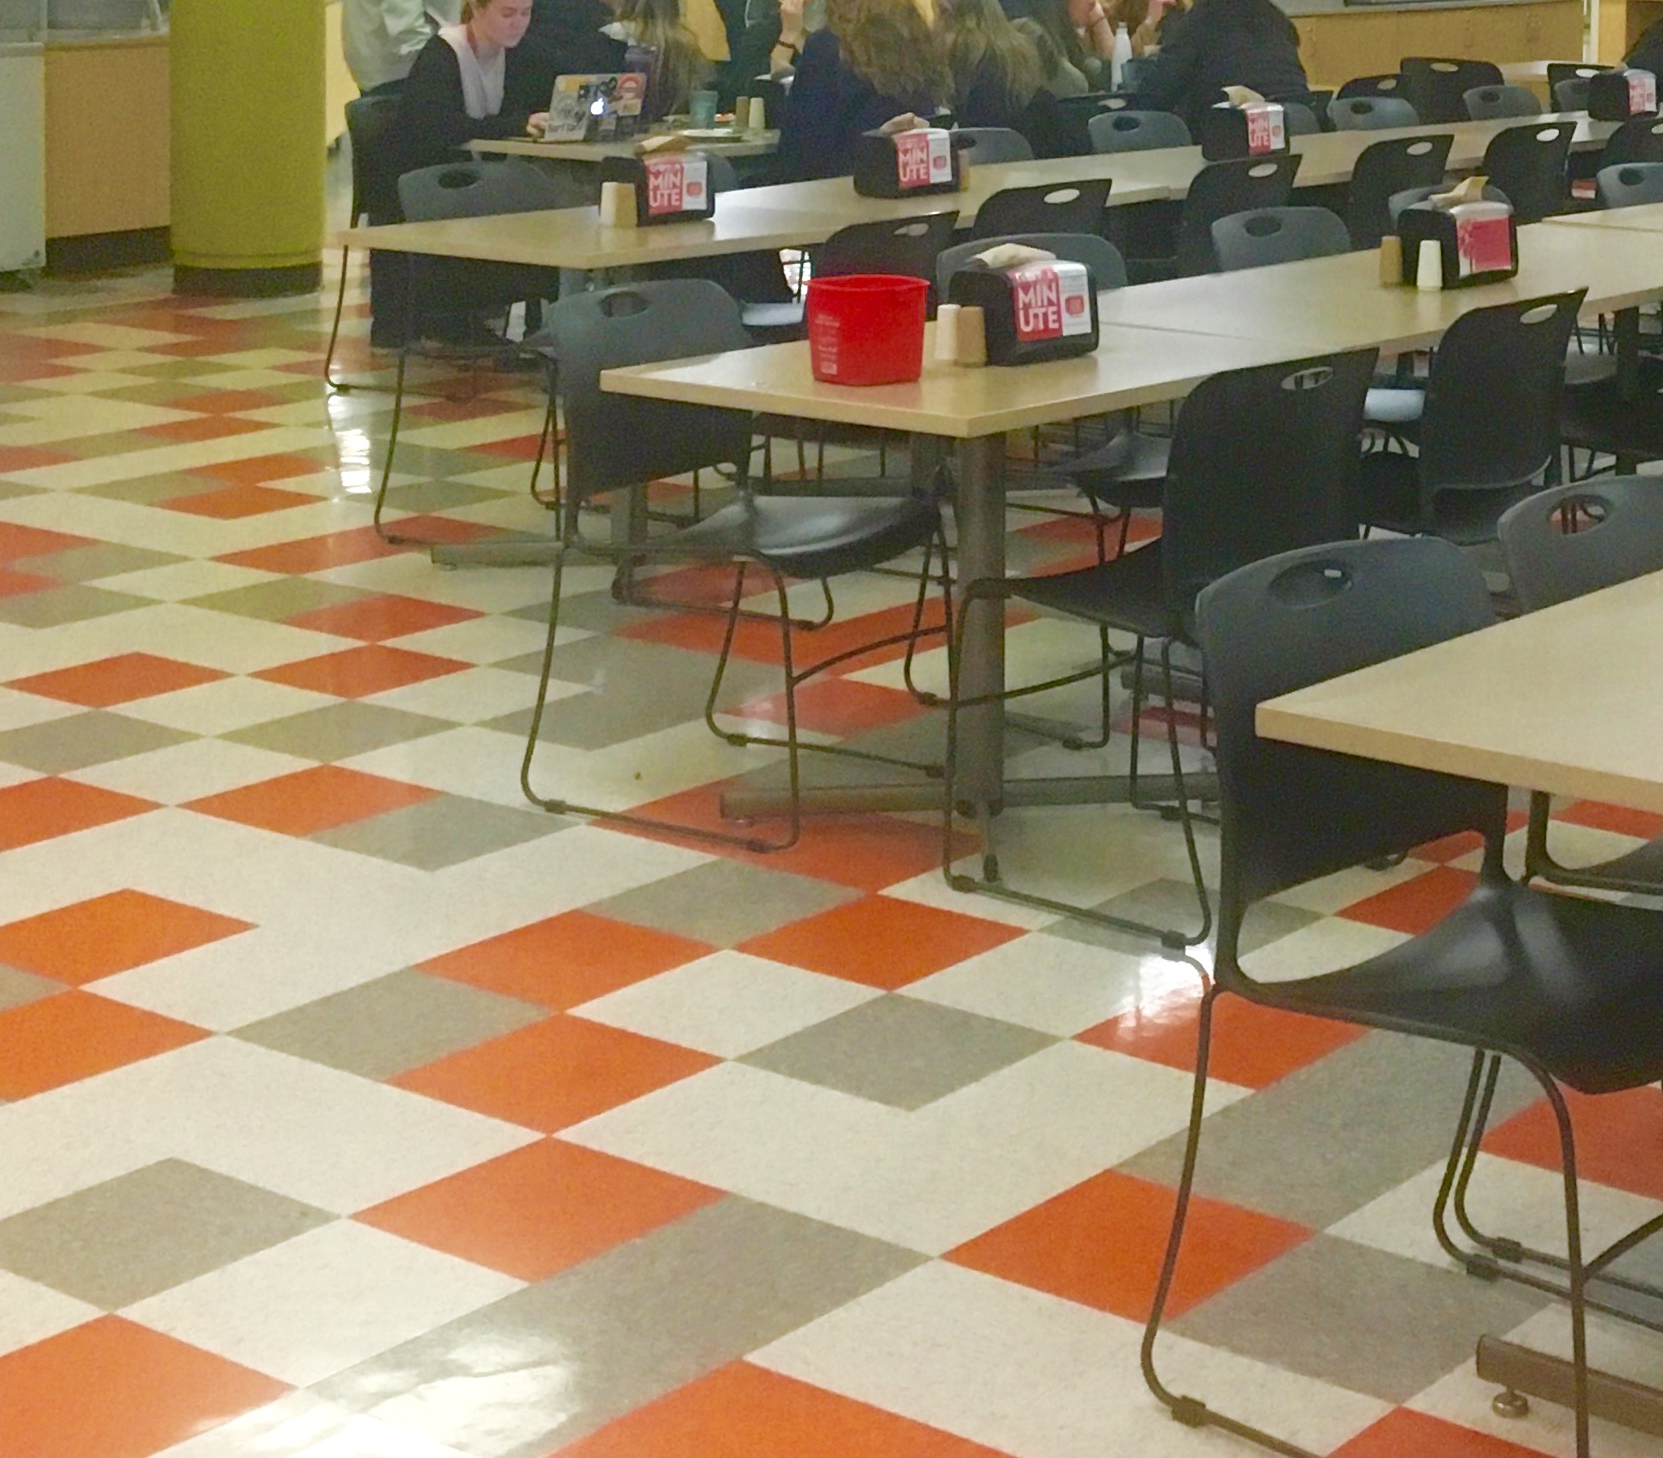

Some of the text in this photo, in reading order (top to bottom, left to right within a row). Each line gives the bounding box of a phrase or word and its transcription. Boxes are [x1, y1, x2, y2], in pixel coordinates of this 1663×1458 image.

[898, 144, 927, 166] MIN
[649, 169, 681, 192] MIN
[899, 163, 929, 182] UTE
[649, 189, 681, 208] UTE
[1018, 282, 1058, 309] MIN
[1019, 306, 1060, 333] UTE
